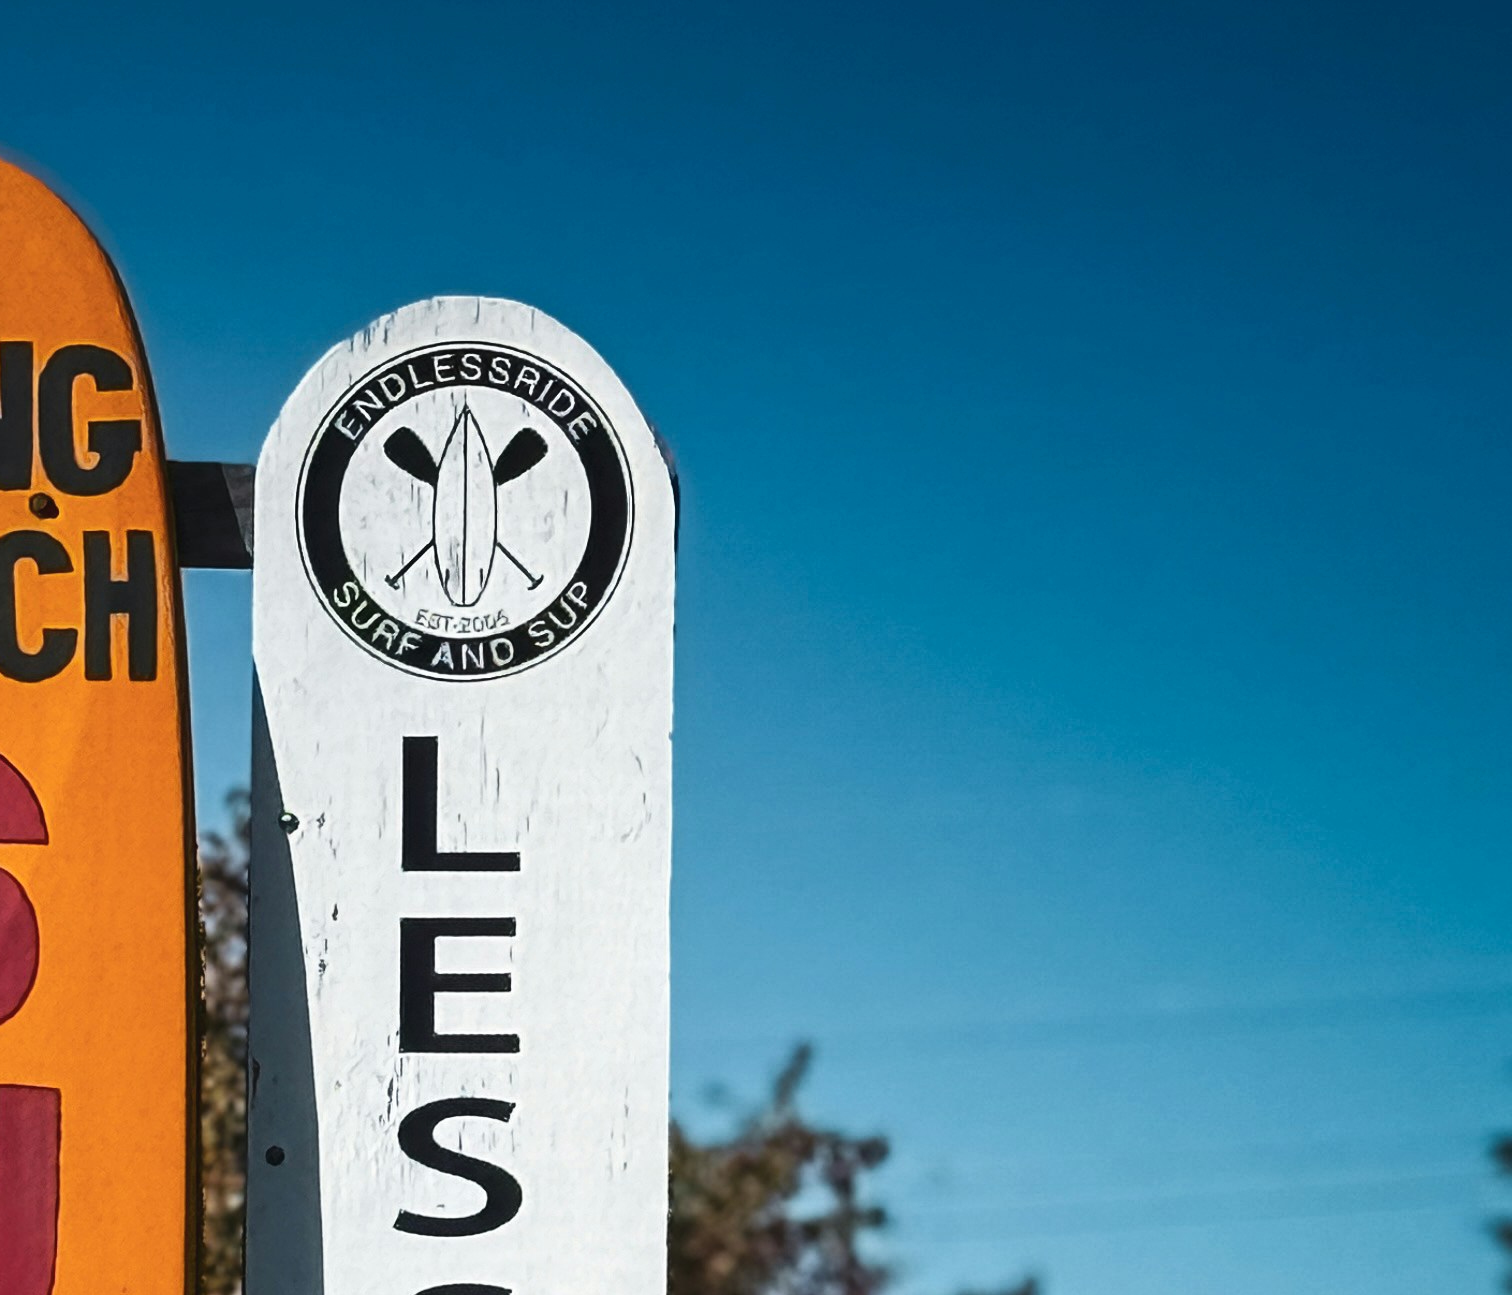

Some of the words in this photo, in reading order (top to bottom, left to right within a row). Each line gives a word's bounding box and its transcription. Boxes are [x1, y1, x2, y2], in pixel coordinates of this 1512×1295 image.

[333, 352, 600, 446] ENDLESSRIDE
[333, 580, 423, 656] SURF
[431, 637, 515, 670] AND
[528, 580, 591, 648] SUP
